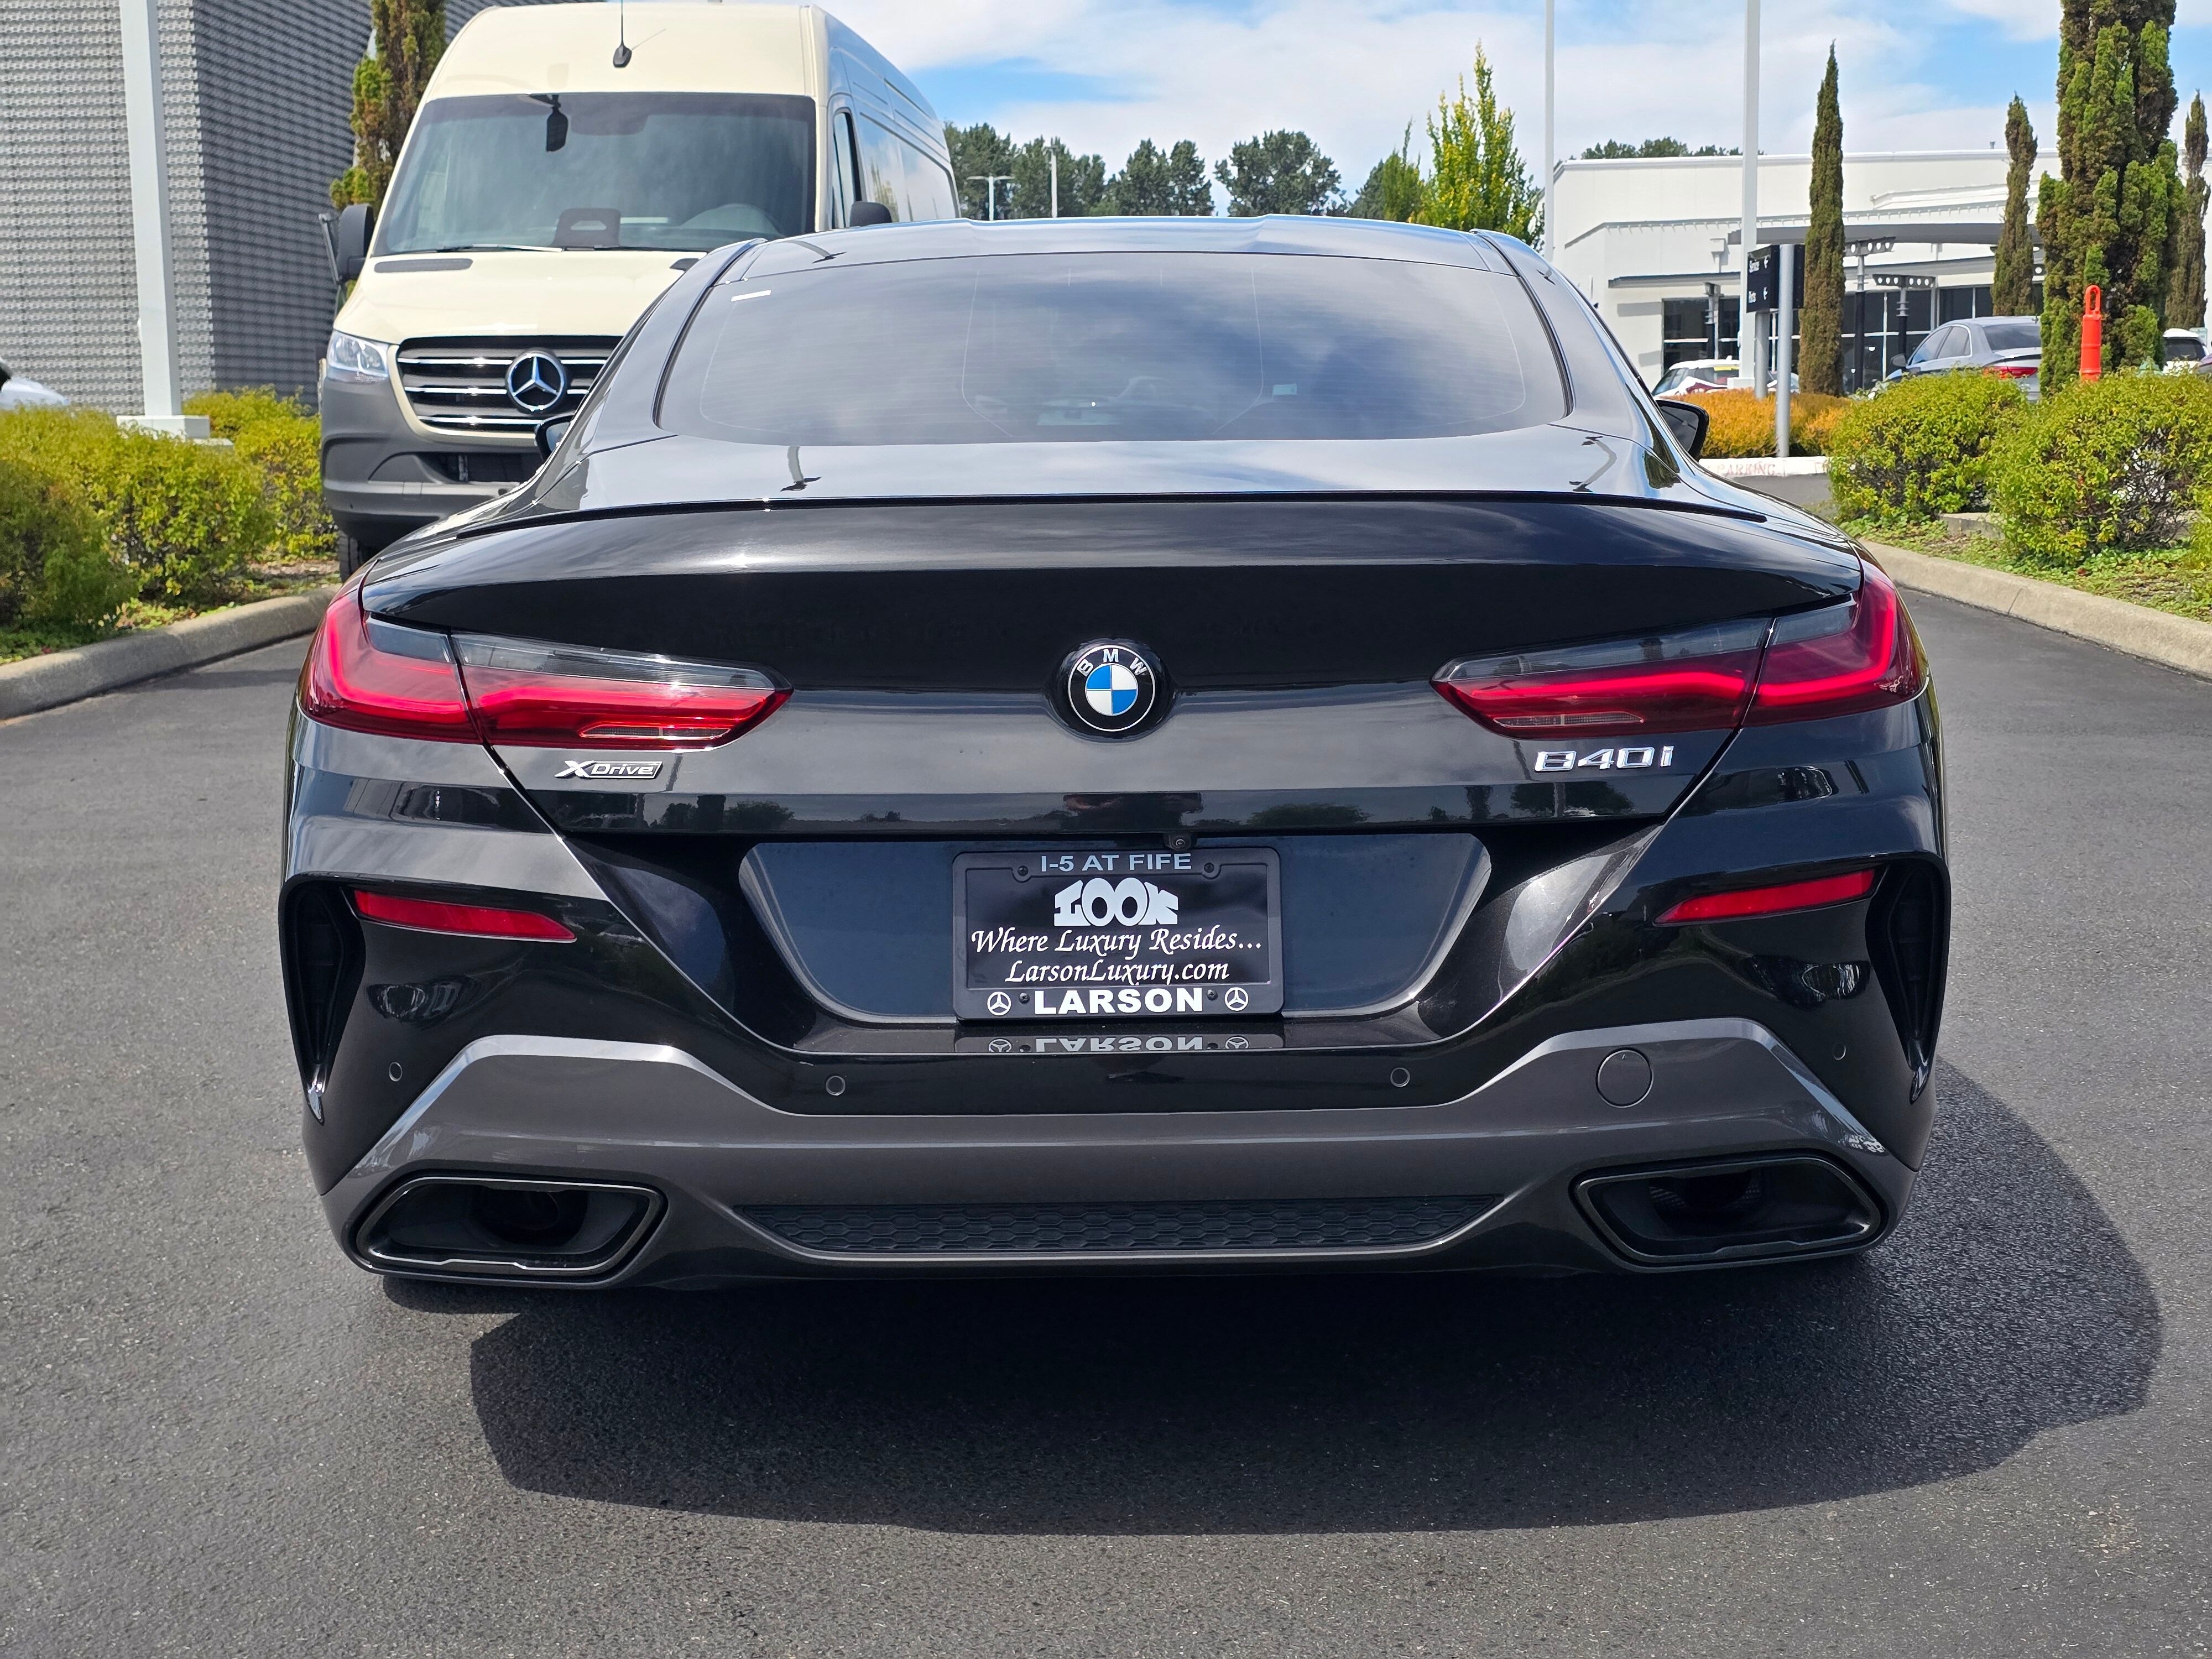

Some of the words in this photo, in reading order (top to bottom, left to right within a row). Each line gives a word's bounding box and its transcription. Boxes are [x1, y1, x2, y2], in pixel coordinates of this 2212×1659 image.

[1717, 462, 1776, 477] PARKING
[1077, 648, 1147, 677] BMW
[1535, 746, 1674, 771] 840i
[1041, 855, 1074, 872] I-5
[1082, 855, 1119, 871] AT
[1129, 853, 1192, 870] FIFE
[1054, 877, 1179, 927] LOOK
[971, 927, 1049, 953] Where
[1054, 930, 1142, 961] Luxury
[1149, 924, 1261, 955] Resides...
[1004, 959, 1230, 986] LarsonLuxury.com
[1034, 987, 1203, 1015] LARSON
